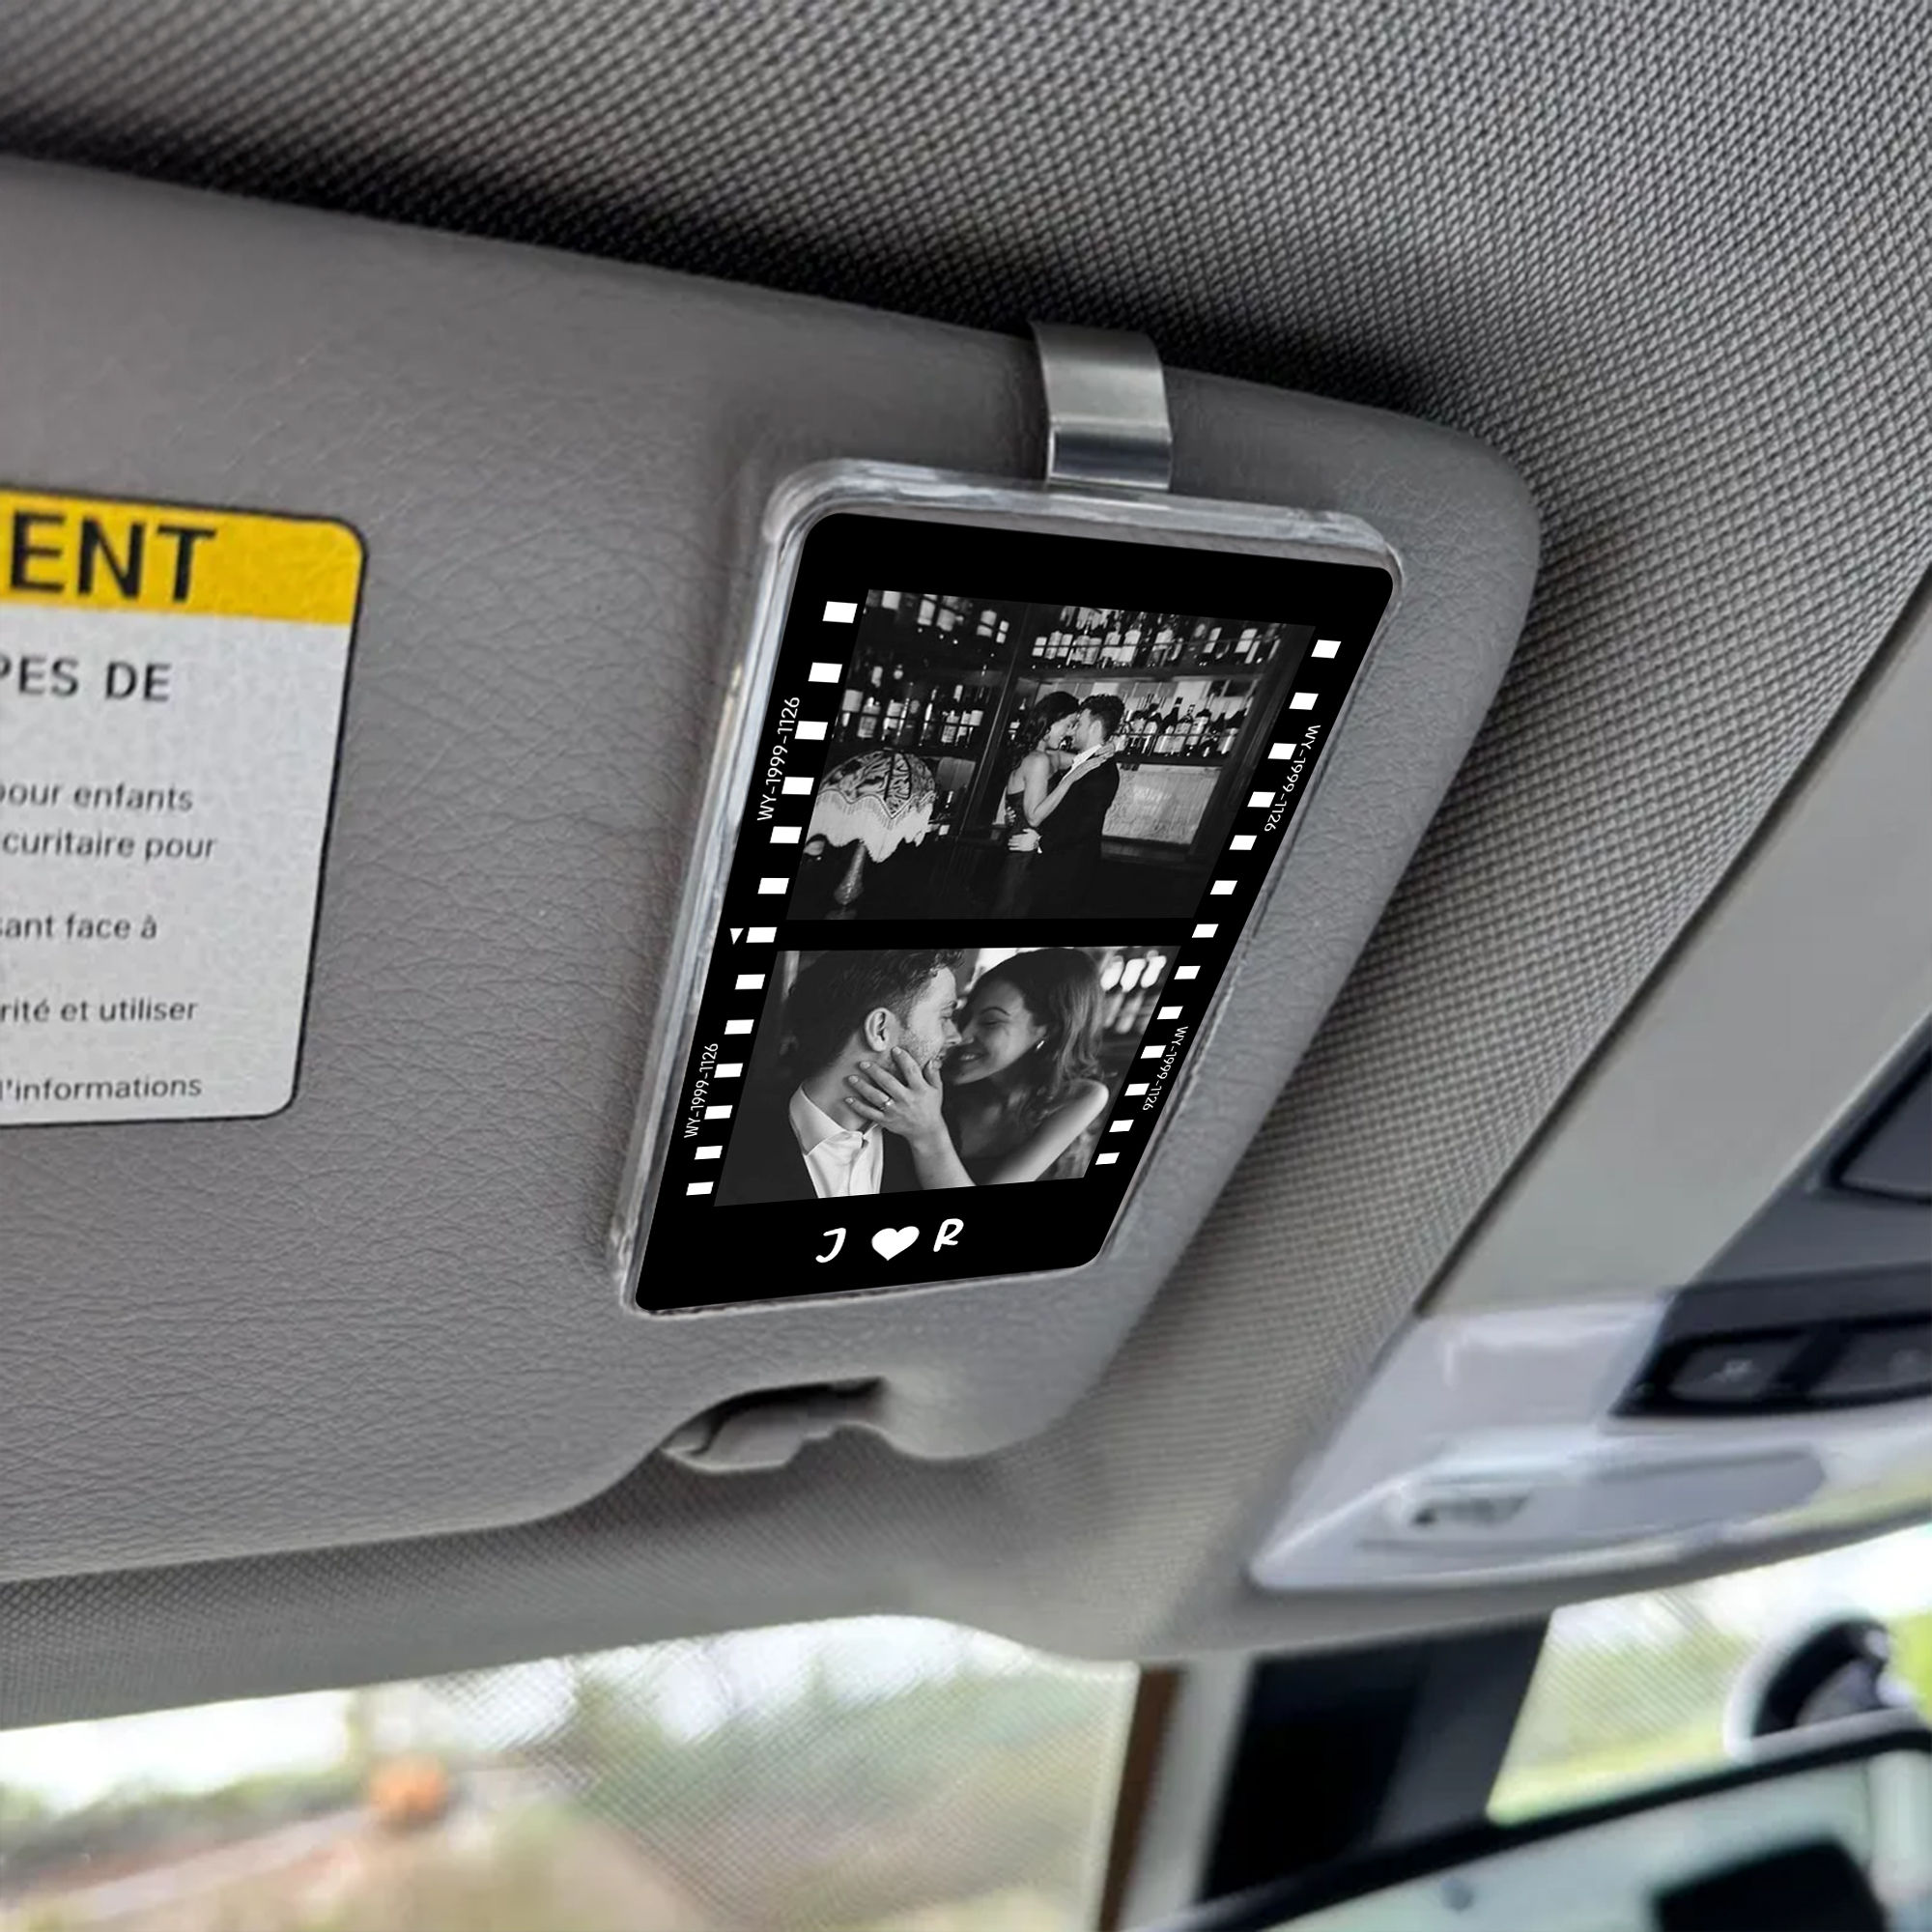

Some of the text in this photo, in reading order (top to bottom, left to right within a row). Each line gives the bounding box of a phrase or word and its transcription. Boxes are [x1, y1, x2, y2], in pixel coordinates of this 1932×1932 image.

[10, 509, 218, 603] ENT
[104, 661, 172, 702] DE
[756, 696, 801, 821] WY-1999-1126
[1264, 724, 1321, 832] WY-1999-1126
[74, 781, 194, 812] enfants
[3, 828, 217, 862] curitaire pour
[0, 913, 158, 940] ant face à
[0, 997, 198, 1022] rité et utiliser
[683, 1043, 719, 1138] WY-1999-1126
[1142, 1026, 1189, 1111] WY-1999-1126
[815, 1218, 964, 1263] J R
